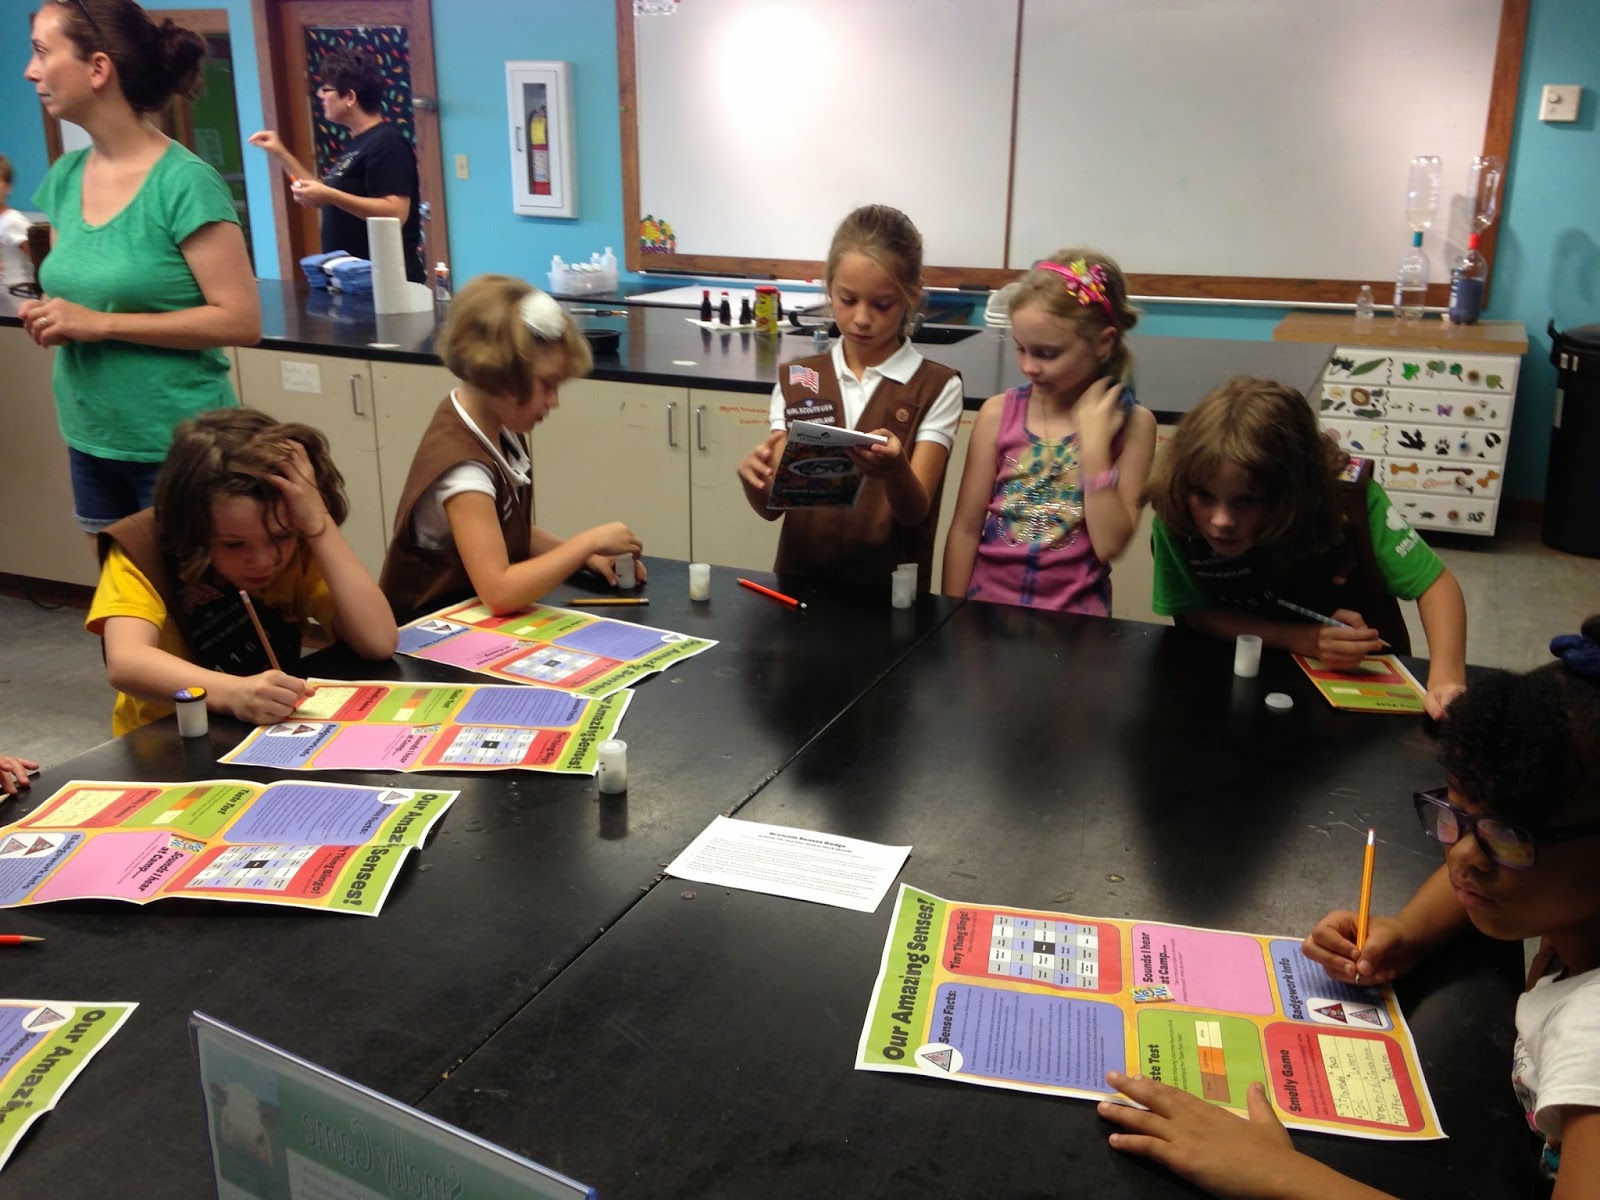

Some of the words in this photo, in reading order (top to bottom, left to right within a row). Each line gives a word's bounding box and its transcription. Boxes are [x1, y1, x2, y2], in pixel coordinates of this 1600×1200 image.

[413, 794, 438, 811] Our
[161, 850, 185, 876] Sounds
[343, 847, 390, 906] Senses!
[138, 876, 159, 892] hear
[310, 867, 333, 895] Bingo!
[906, 897, 935, 951] Senses!
[956, 911, 971, 931] Bingo!
[952, 929, 968, 951] Thing
[1140, 932, 1151, 949] hear
[950, 950, 964, 969] Tiny
[1141, 954, 1153, 983] Sounds
[1279, 957, 1292, 974] Info
[891, 951, 930, 1025] Amazing
[1159, 975, 1170, 985] at
[943, 990, 957, 1016] Facts:
[1282, 974, 1304, 1019] Badgework
[65, 1010, 106, 1043] Our
[938, 1016, 953, 1044] Sense
[883, 1025, 909, 1060] Our
[1148, 1044, 1160, 1064] Test
[1280, 1049, 1294, 1077] Game
[1284, 1079, 1302, 1112] Smelly
